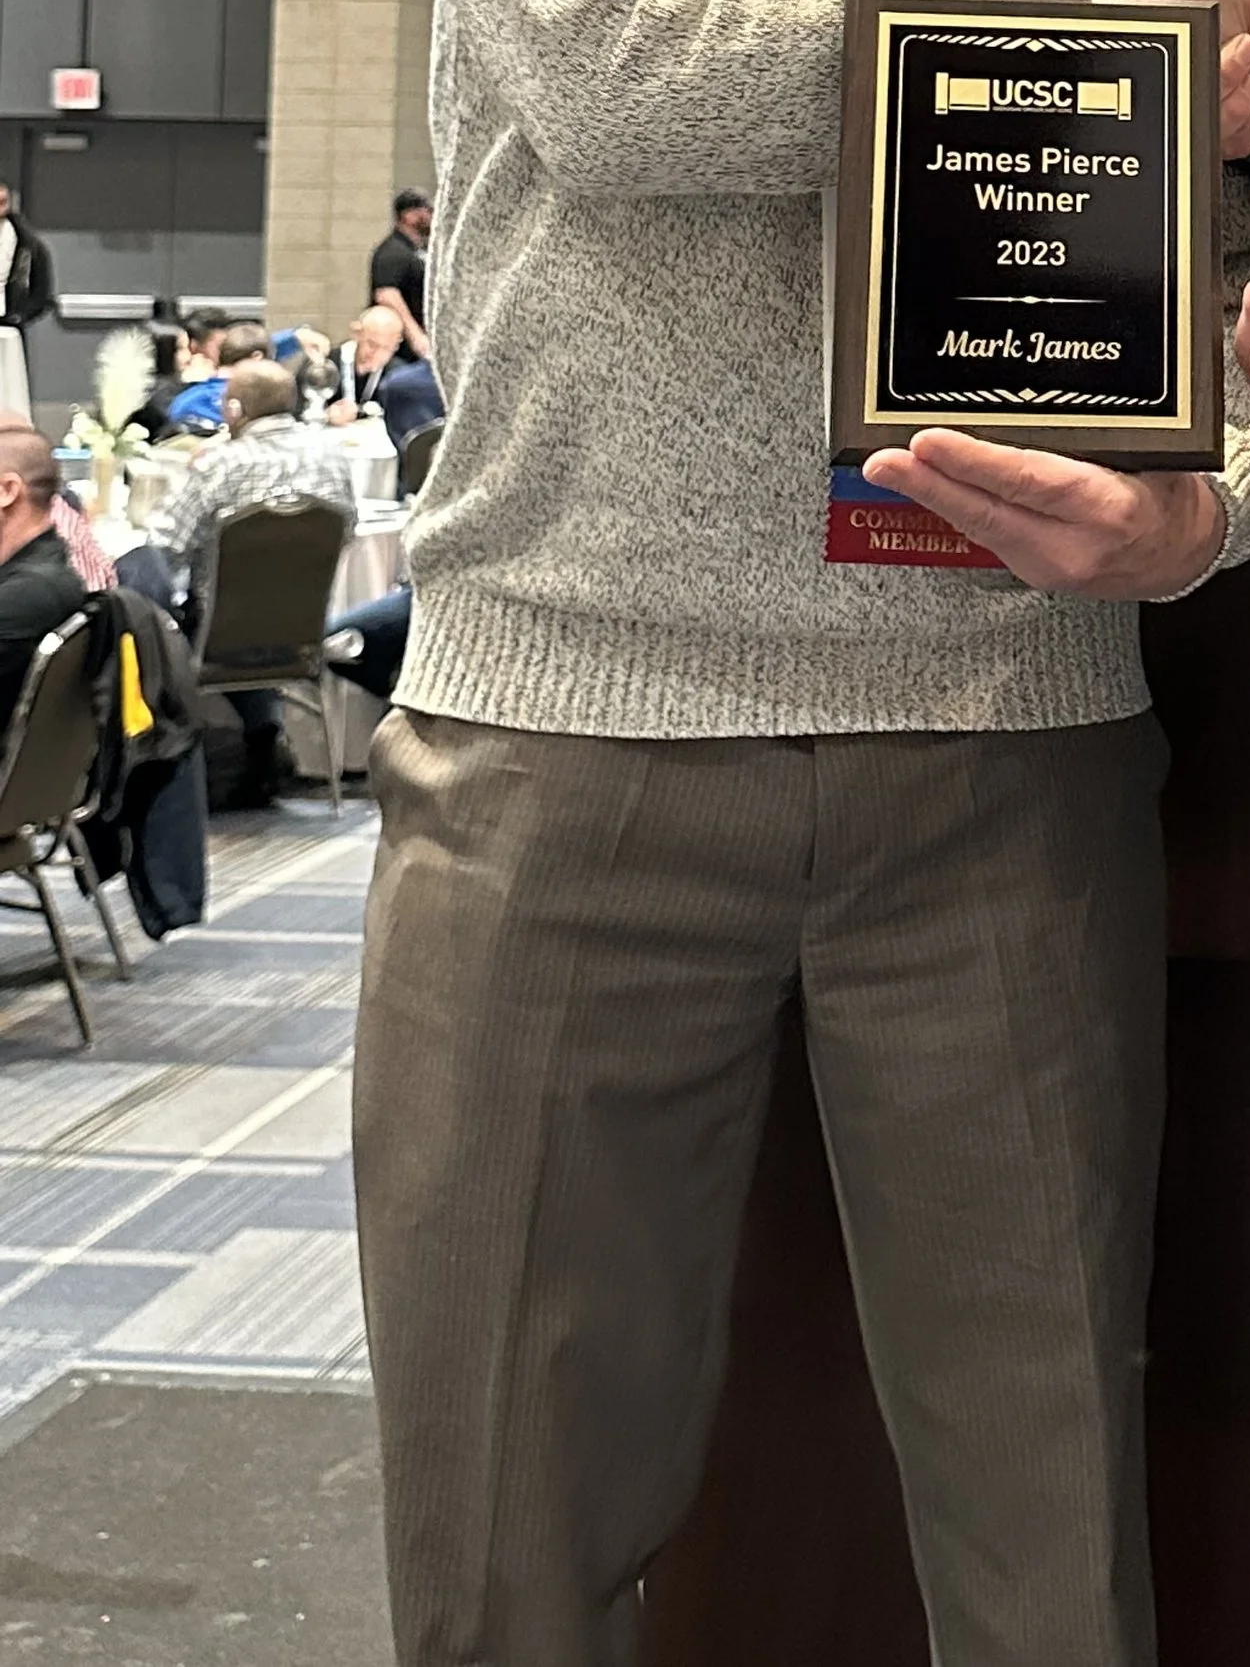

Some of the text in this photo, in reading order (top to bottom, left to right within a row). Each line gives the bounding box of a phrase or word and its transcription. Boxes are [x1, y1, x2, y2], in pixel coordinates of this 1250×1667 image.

[992, 79, 1074, 108] UCSC
[925, 144, 1140, 177] James Pierce
[974, 183, 1091, 213] Winner
[996, 240, 1067, 267] 2023
[936, 328, 1123, 364] Mark James
[868, 531, 971, 554] MEMBER
